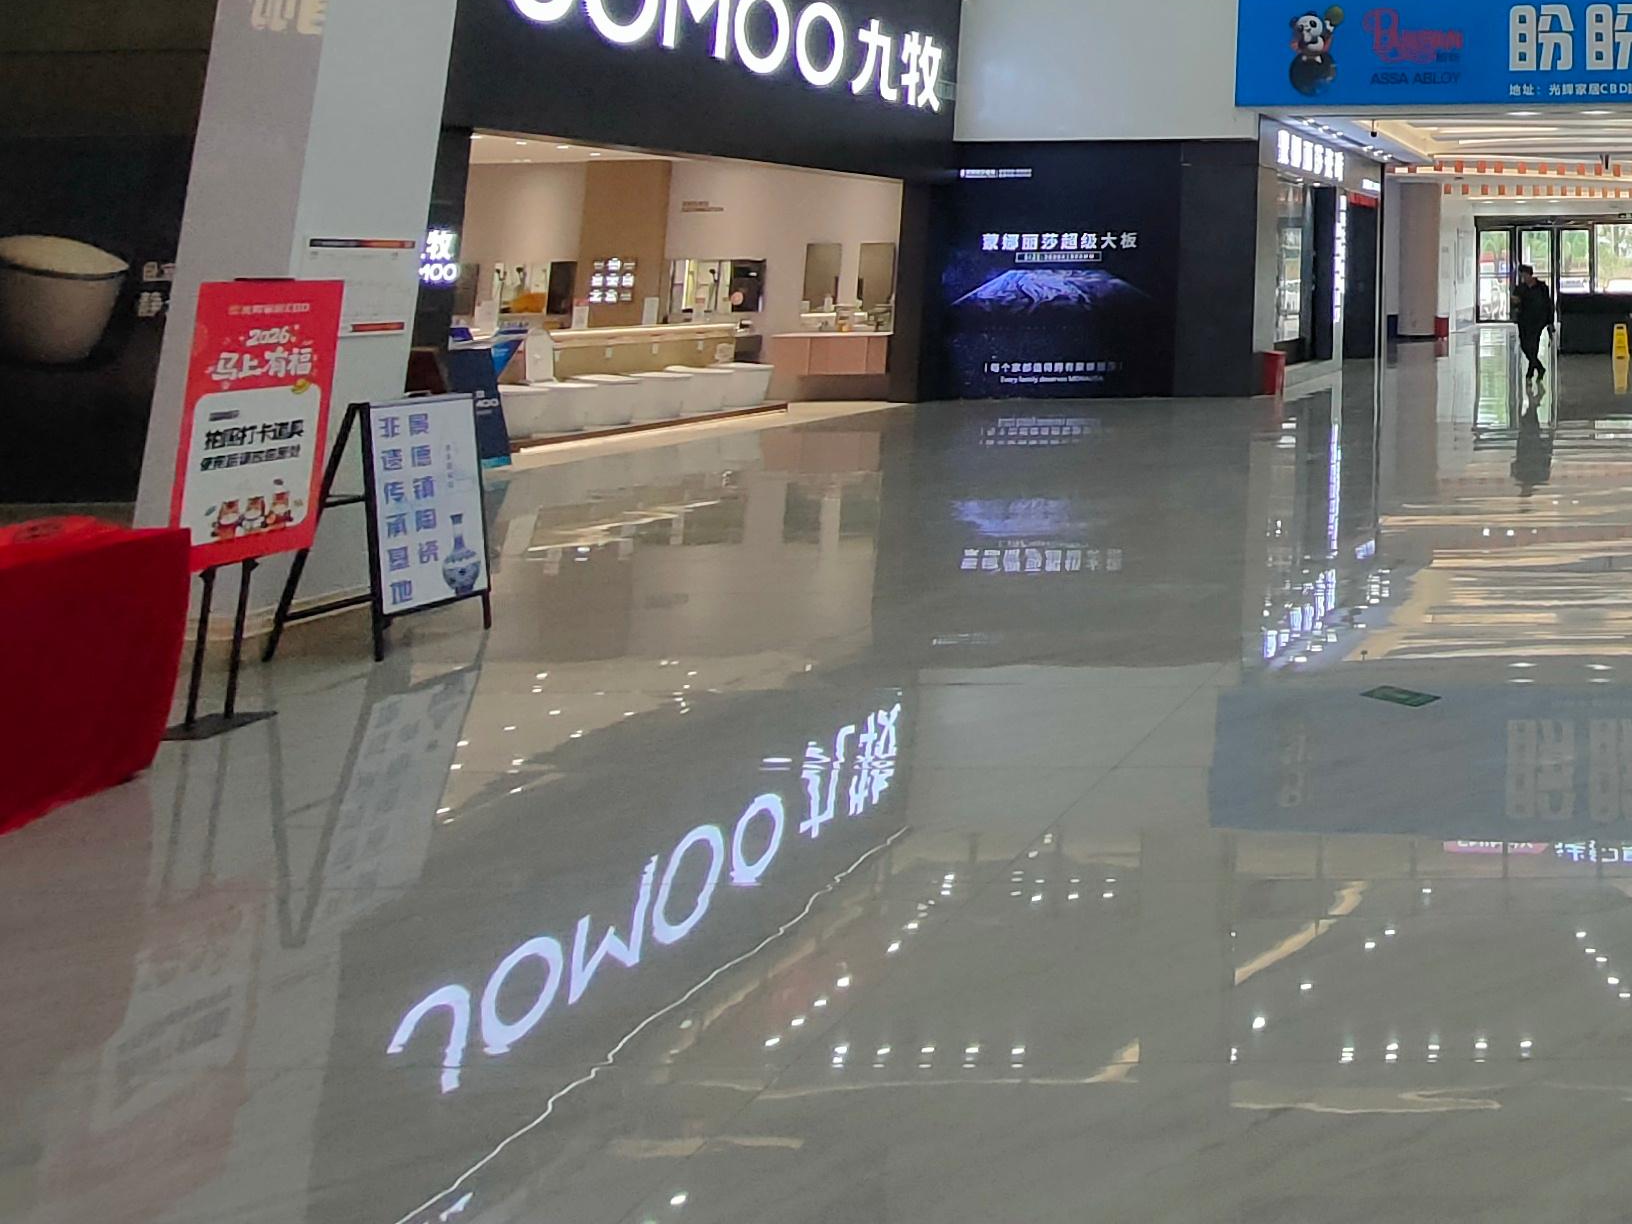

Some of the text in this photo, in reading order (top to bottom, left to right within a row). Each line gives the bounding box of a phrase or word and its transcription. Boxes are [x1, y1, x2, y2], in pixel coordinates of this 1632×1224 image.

[848, 17, 944, 113] 九牧
[981, 231, 1139, 251] 蒙娜丽莎超级大板
[246, 325, 291, 347] 2026
[211, 346, 314, 382] 马上有福
[377, 415, 413, 606] 非遗传承基地
